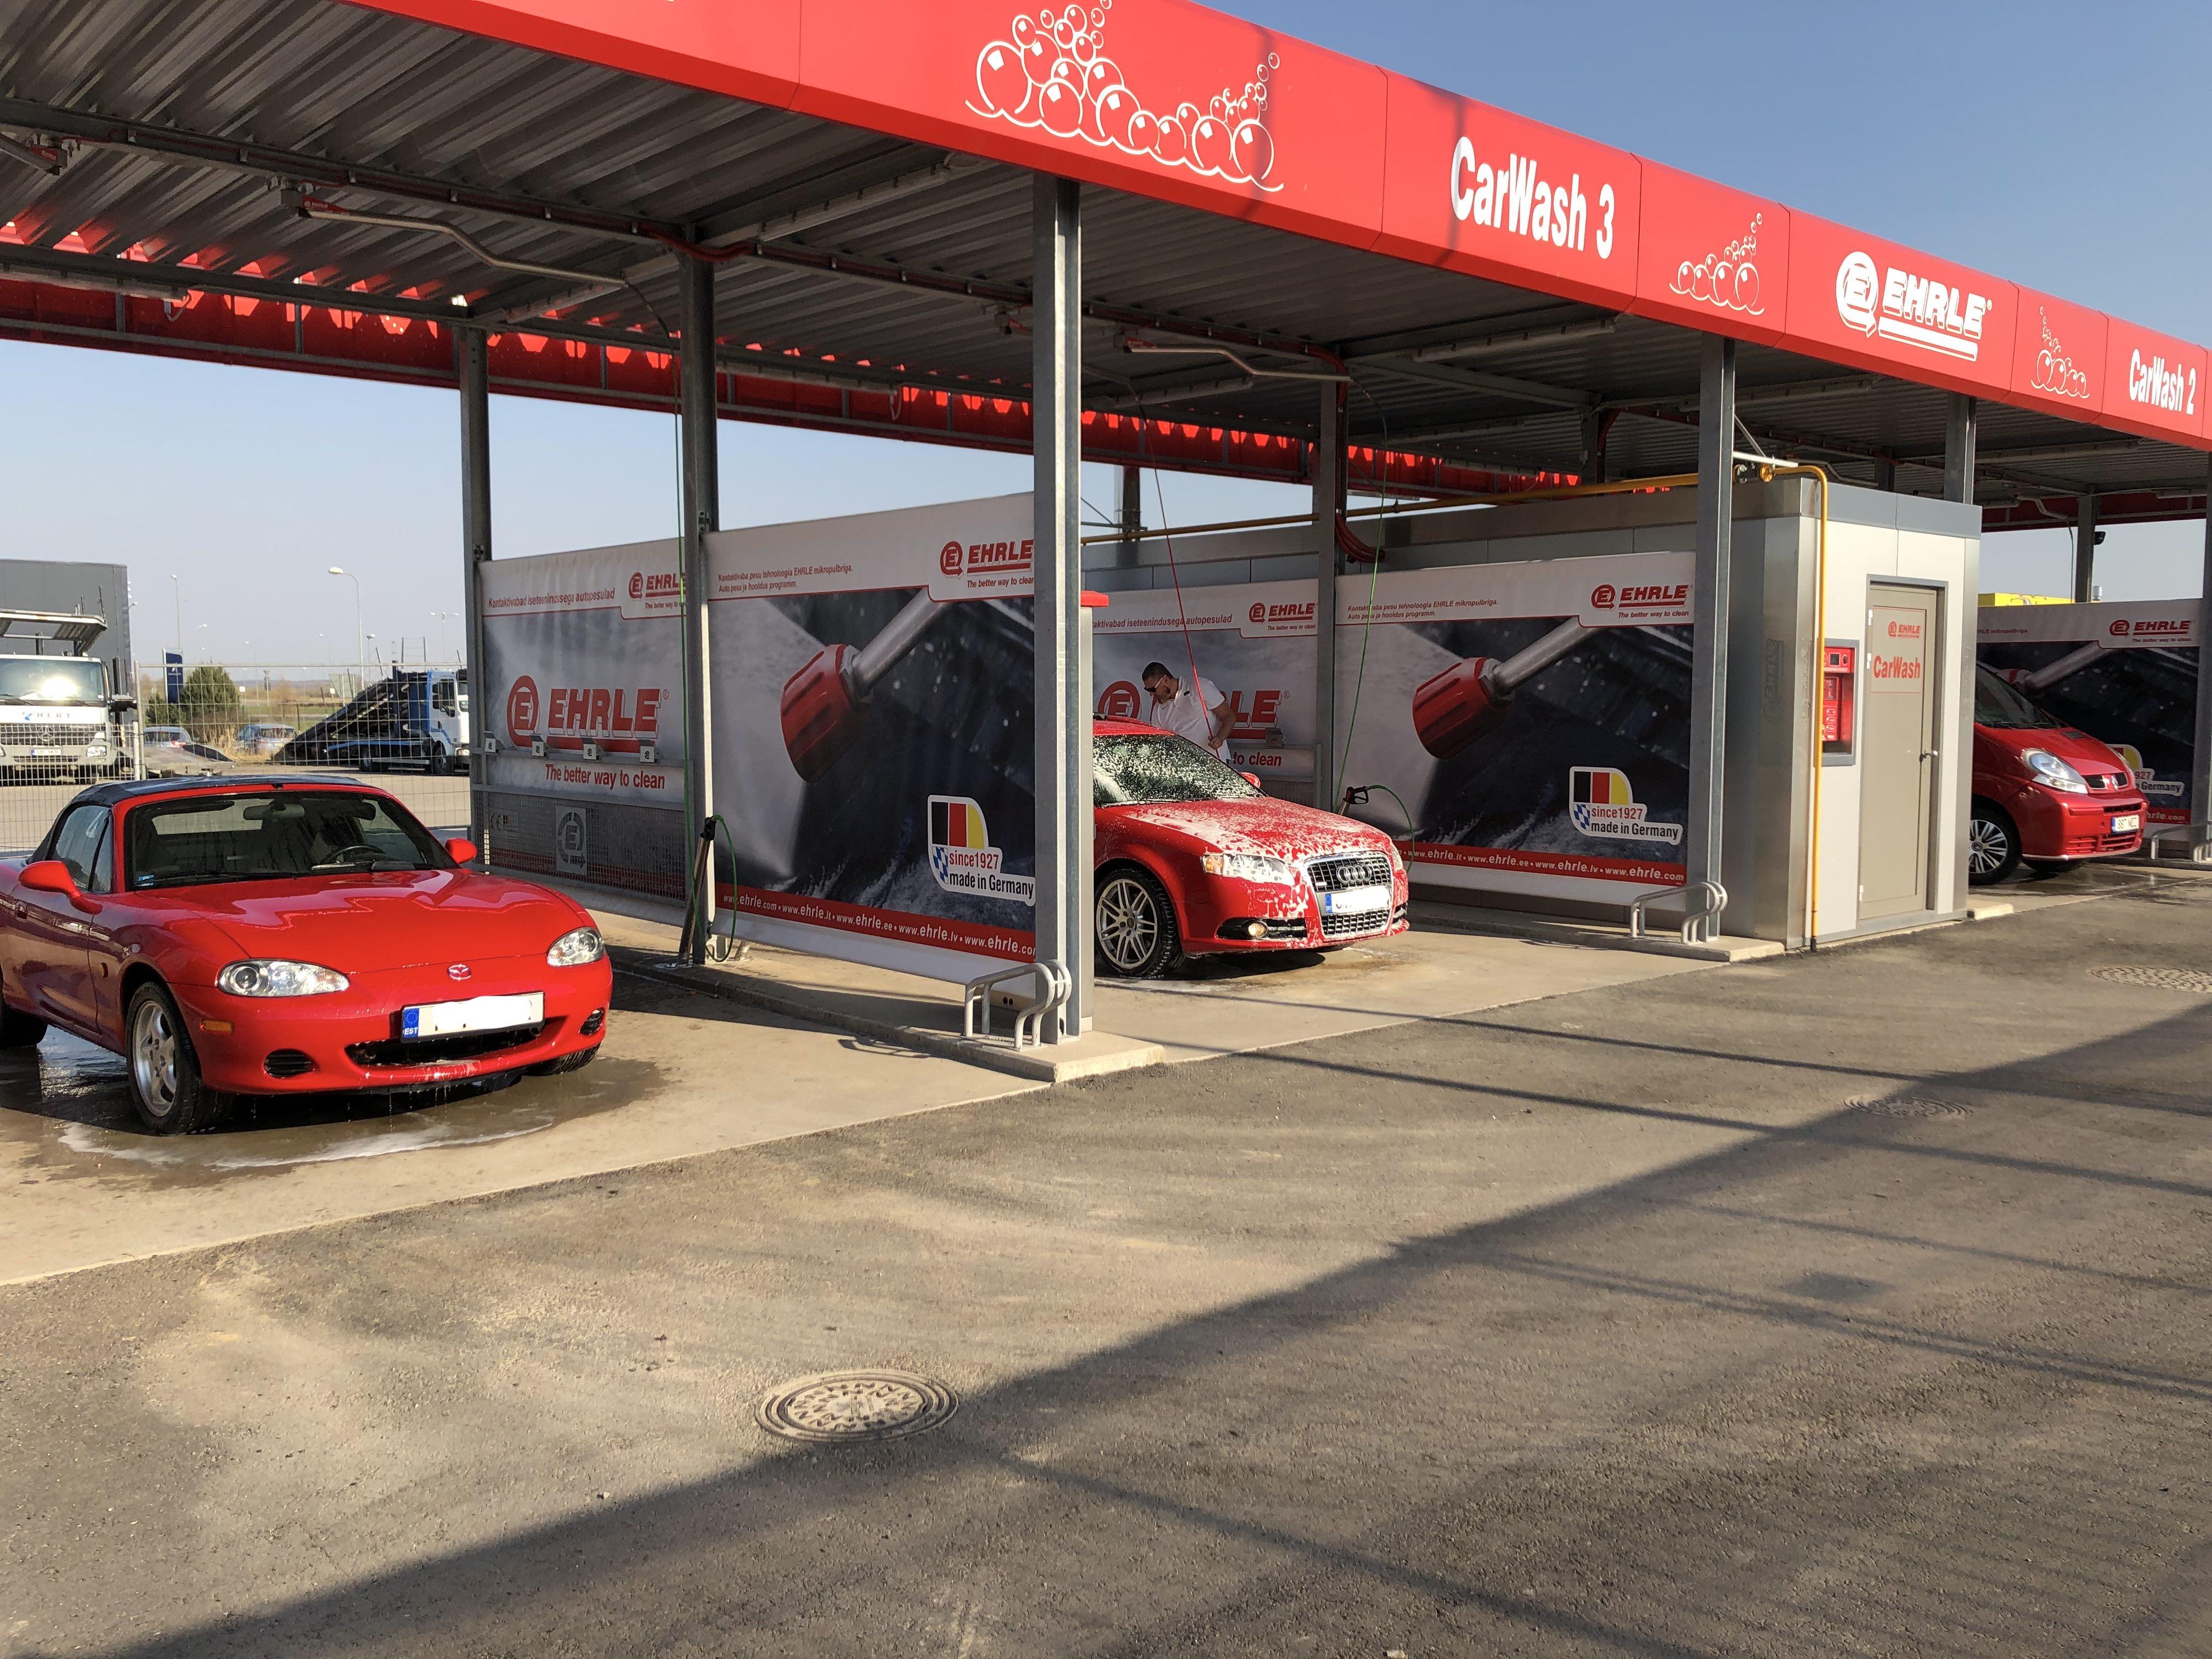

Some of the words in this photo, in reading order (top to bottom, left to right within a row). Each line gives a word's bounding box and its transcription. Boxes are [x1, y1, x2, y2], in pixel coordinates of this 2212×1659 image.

[1451, 136, 1587, 251] CarWash
[1596, 183, 1615, 259] 3
[2129, 348, 2184, 413] CarWash
[2186, 368, 2197, 415] 2
[967, 539, 1034, 566] EHRLE
[763, 570, 793, 579] tehnoloogia
[794, 566, 813, 576] EHRLE
[719, 584, 730, 592] Auto
[731, 585, 742, 594] pesu
[742, 584, 747, 593] ja
[748, 582, 768, 591] hooldus
[769, 580, 798, 591] programm.
[967, 580, 977, 588] The
[978, 579, 996, 588] better
[998, 579, 1009, 588] way
[1011, 577, 1018, 585] to
[1620, 584, 1689, 601] EHRLE
[1269, 602, 1316, 617] EHRLE
[1399, 602, 1432, 610] tehnoloogia
[1092, 618, 1126, 628] aktivabad
[1127, 617, 1185, 628] iseteenindusega
[1186, 613, 1233, 625] autopesulad
[2134, 620, 2191, 631] EHRLE
[1873, 655, 1921, 679] CarWash
[1233, 752, 1245, 765] to
[1249, 752, 1282, 766] clean
[545, 763, 562, 781] The
[563, 765, 591, 784] better
[594, 771, 617, 791] way
[619, 769, 630, 787] to
[633, 770, 665, 789] clean
[2141, 781, 2181, 793] Germany
[1591, 805, 1643, 820] since1927
[1591, 821, 1618, 833] made
[1621, 821, 1629, 834] in
[1632, 822, 1679, 840] Germany
[949, 849, 1000, 870] since1927
[1468, 854, 1529, 867] www.ehrle.ee
[1535, 860, 1599, 873] www.ehrle.lv
[1605, 866, 1685, 882] www.ehrle.com
[950, 872, 975, 888] made
[977, 873, 987, 890] in
[989, 874, 1034, 900] Germany
[782, 904, 831, 921] www.ehrle.lt
[836, 912, 893, 932] www.ehrle.ee
[899, 923, 958, 943] www.ehrle.lv
[404, 1027, 418, 1035] EST
